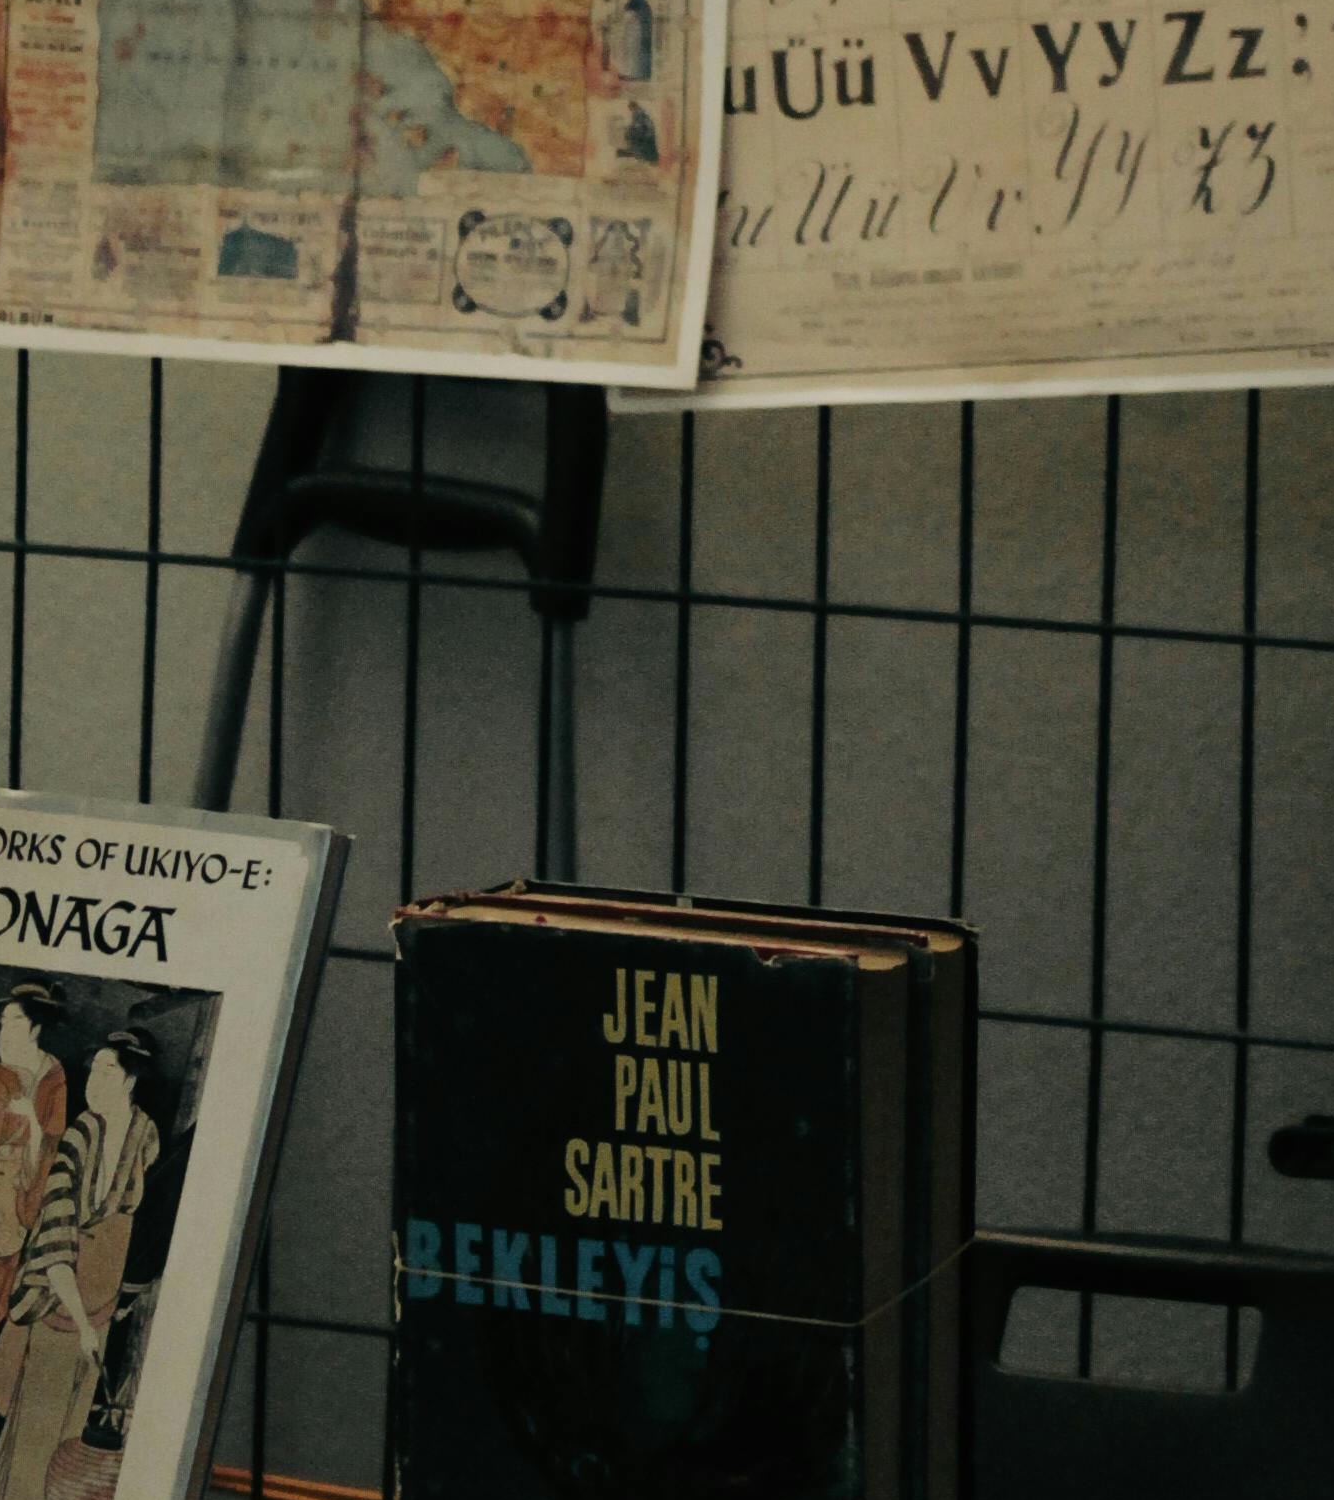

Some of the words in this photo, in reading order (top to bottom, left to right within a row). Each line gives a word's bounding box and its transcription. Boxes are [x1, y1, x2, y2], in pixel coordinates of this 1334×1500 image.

[74, 837, 121, 871] OF
[124, 845, 274, 892] UKIYO-E:
[602, 966, 719, 1054] JEAN
[613, 1054, 722, 1143] PAUL
[563, 1136, 724, 1232] SARTRE
[405, 1216, 724, 1352] BEKLEYİŞ
